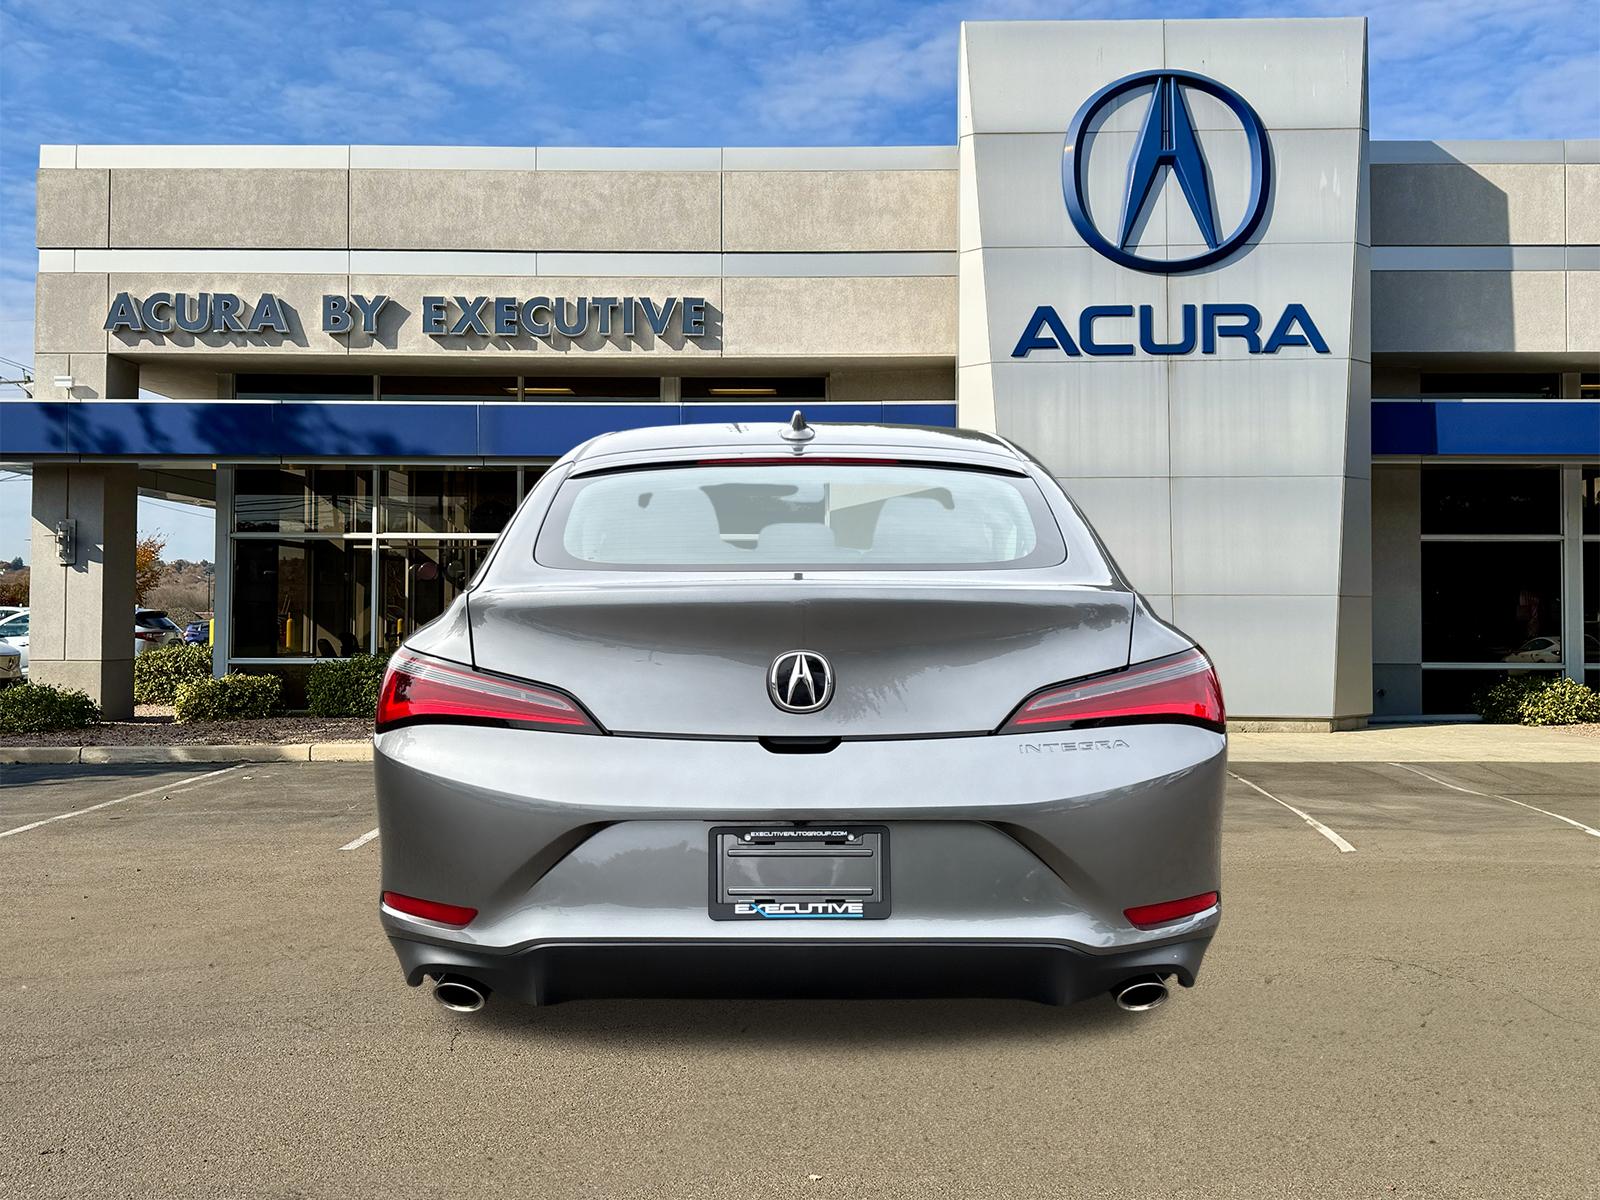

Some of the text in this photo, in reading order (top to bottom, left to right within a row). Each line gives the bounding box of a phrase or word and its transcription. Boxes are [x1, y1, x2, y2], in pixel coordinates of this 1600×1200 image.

[103, 291, 706, 336] ACURA BY EXECUTIVE
[1010, 303, 1331, 357] ACURA
[1019, 739, 1130, 754] INTEGRA
[734, 902, 864, 915] EXECUTIVE
